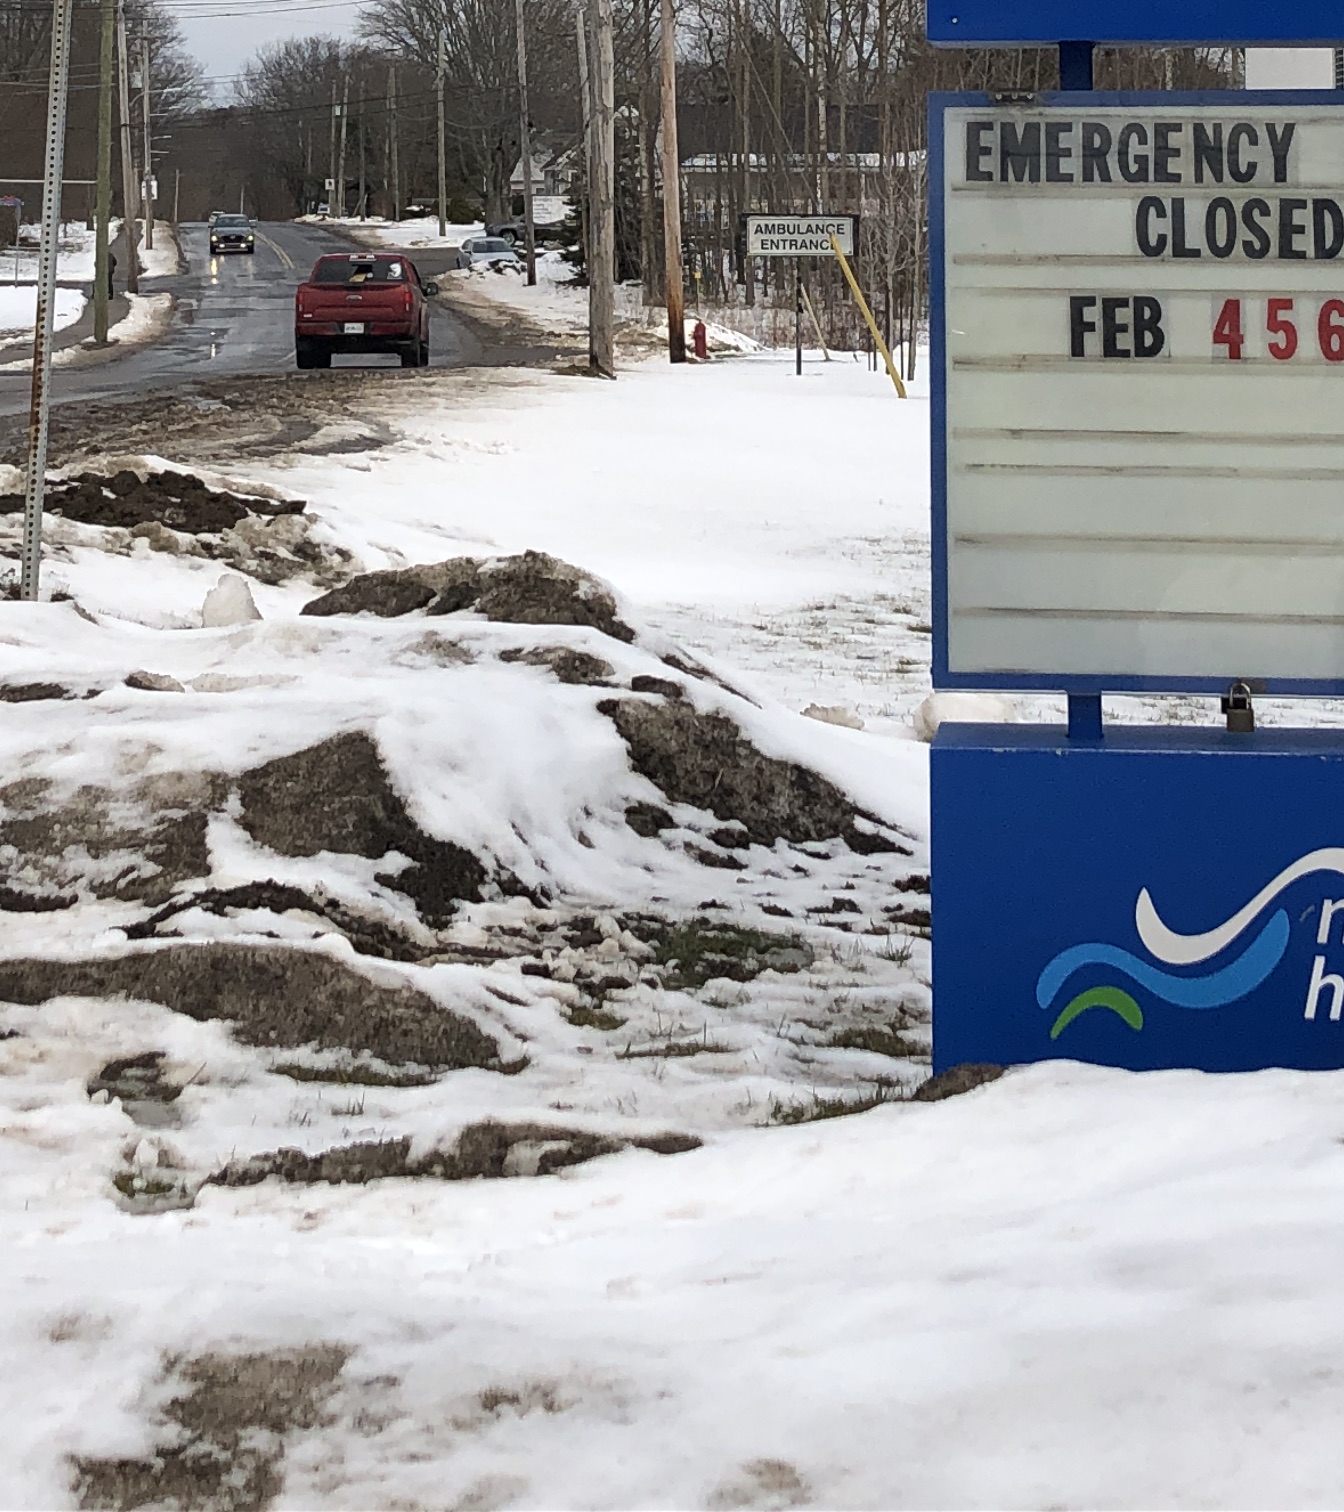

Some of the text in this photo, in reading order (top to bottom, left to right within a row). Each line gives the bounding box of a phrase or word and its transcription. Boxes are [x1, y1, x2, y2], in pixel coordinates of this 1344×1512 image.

[965, 120, 1296, 185] EMERGENCY
[754, 223, 845, 235] AMBULANCE
[760, 238, 836, 250] ENTRANC
[1068, 295, 1165, 359] FEB
